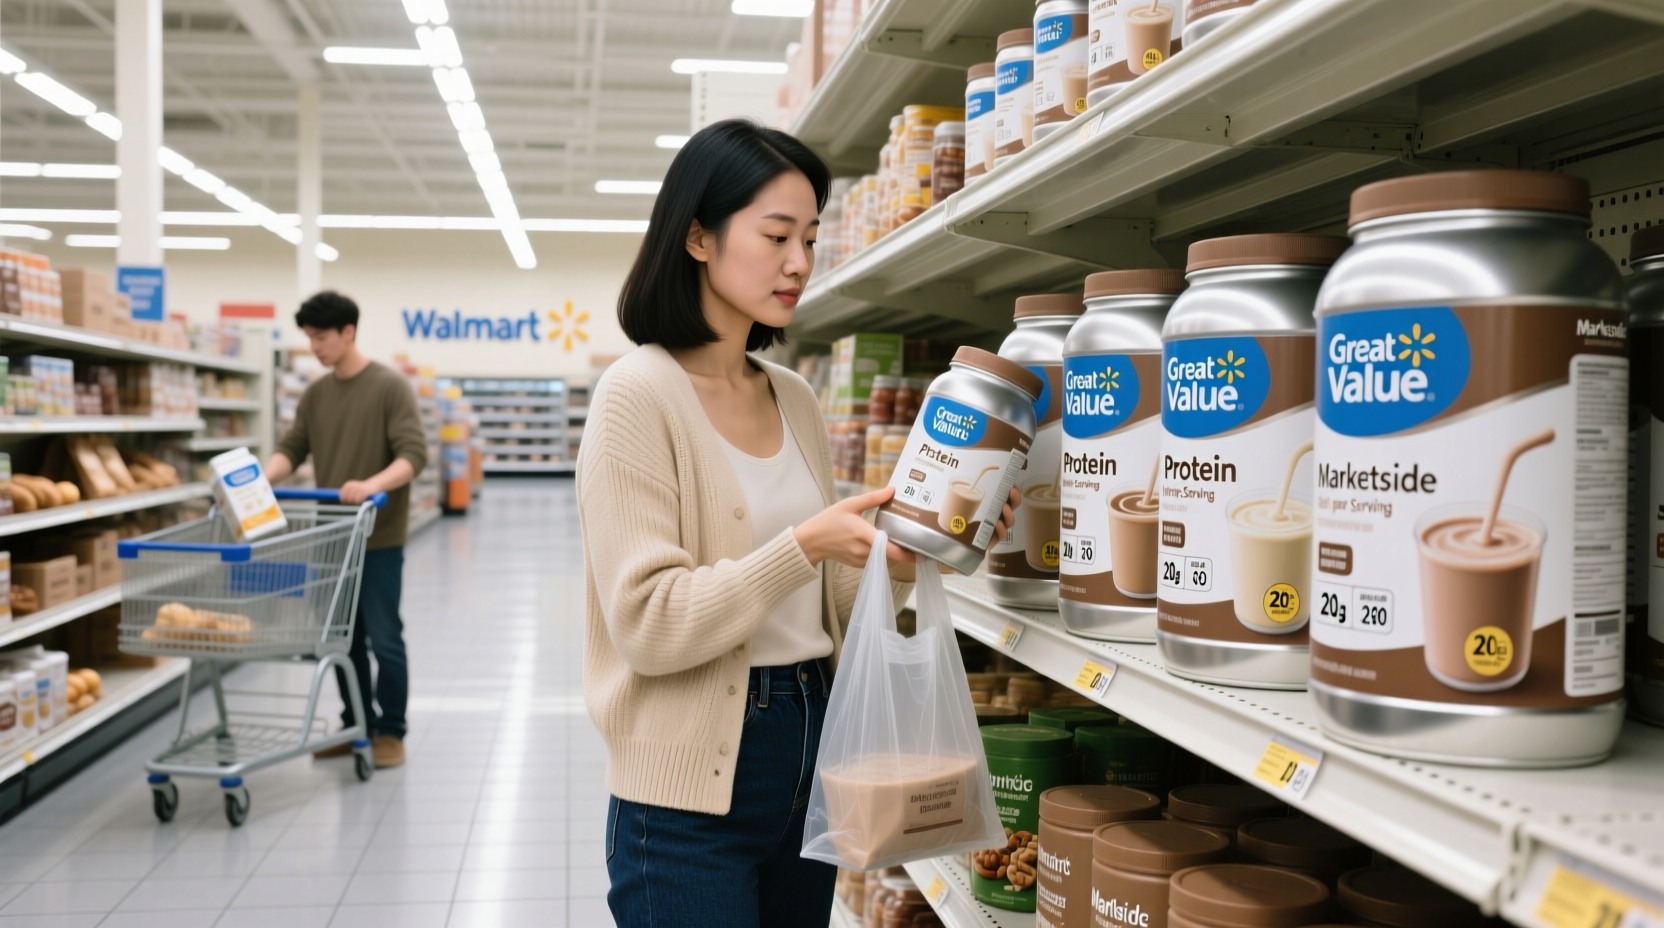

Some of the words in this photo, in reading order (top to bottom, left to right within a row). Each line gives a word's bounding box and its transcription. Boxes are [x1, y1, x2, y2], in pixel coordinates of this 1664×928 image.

[402, 309, 540, 342] Walmart
[1328, 332, 1396, 364] Great
[1066, 370, 1098, 390] Great
[1167, 356, 1215, 381] Great
[1327, 363, 1428, 403] Value
[1065, 391, 1115, 416] Value
[1167, 380, 1239, 411] Value
[1063, 451, 1117, 476] Protein
[1164, 454, 1237, 482] Protein
[1318, 461, 1437, 494] Marketside
